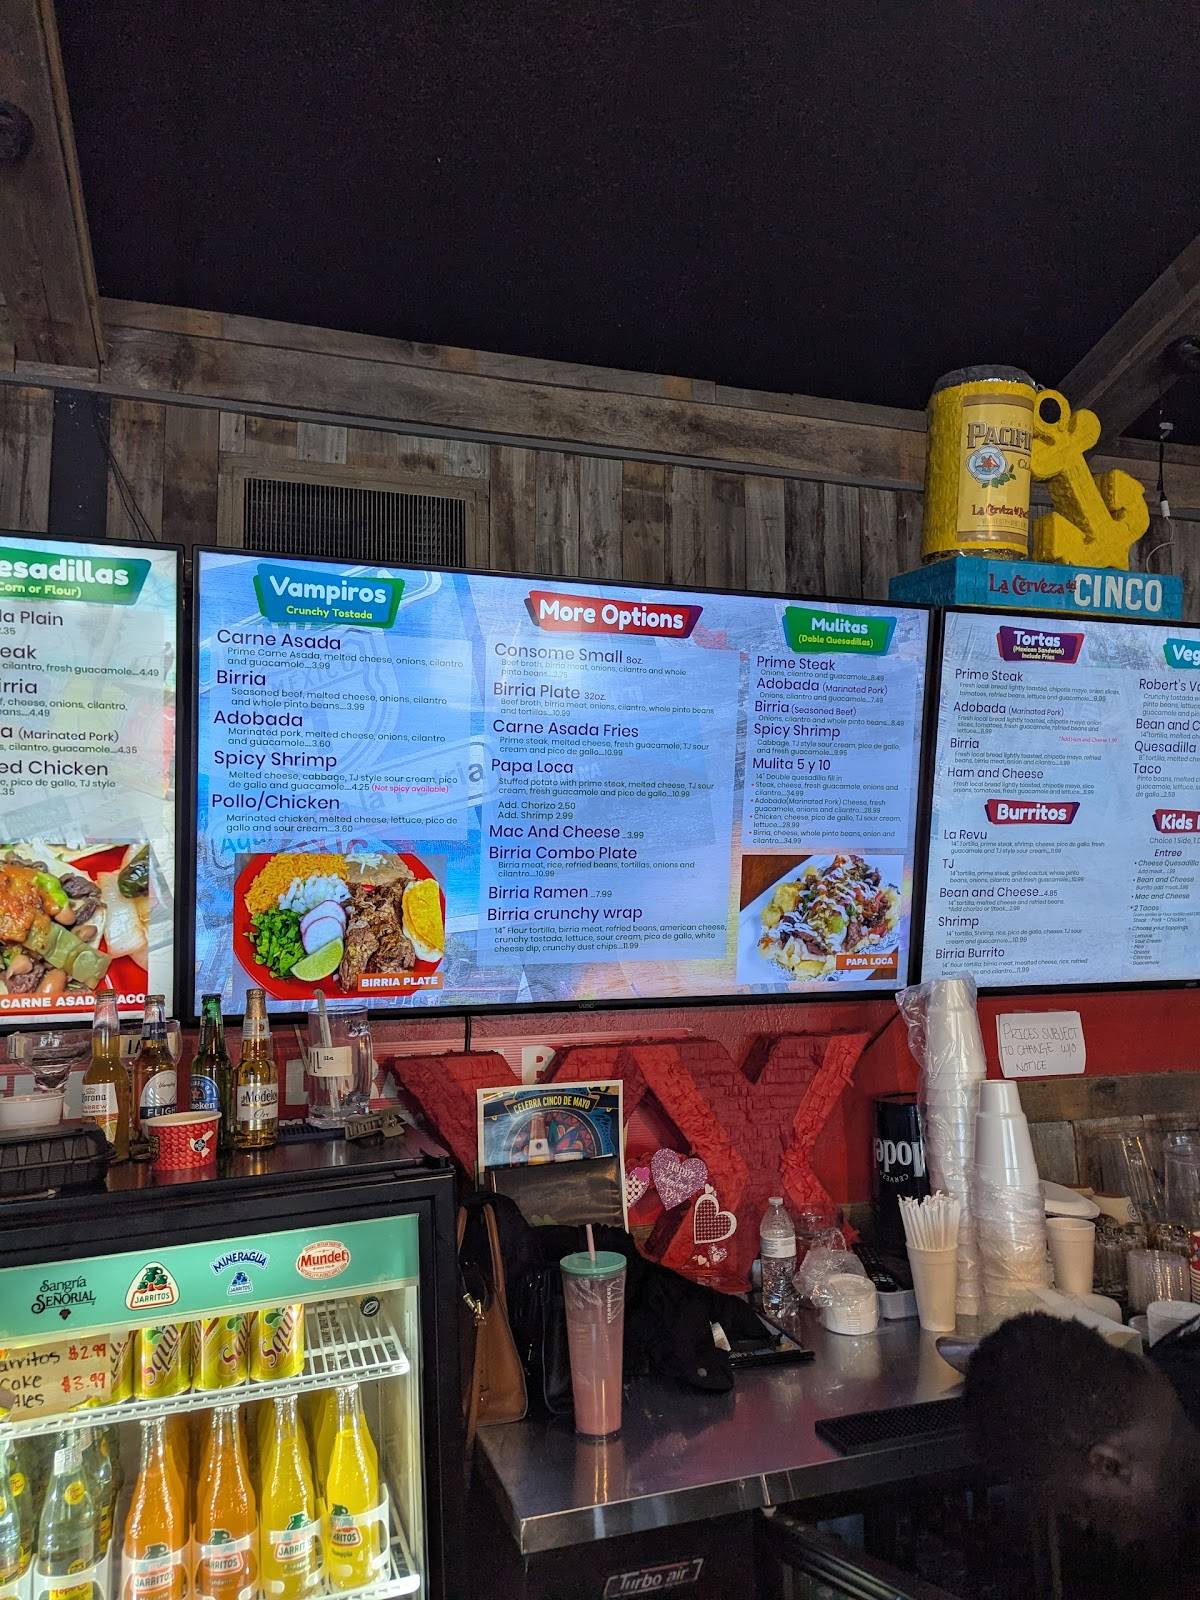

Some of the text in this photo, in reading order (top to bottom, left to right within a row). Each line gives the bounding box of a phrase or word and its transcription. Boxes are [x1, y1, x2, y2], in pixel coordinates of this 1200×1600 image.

[971, 504, 985, 515] La
[28, 584, 82, 599] or Flour)
[269, 575, 387, 606] Vampiros
[989, 574, 1009, 593] La
[1012, 574, 1064, 596] Cerveza
[1074, 573, 1163, 612] CINCO
[20, 611, 64, 626] Plain
[286, 605, 373, 620] Crunchy Tostada
[539, 600, 684, 631] More Options
[811, 617, 868, 634] Mulitas
[217, 629, 341, 650] Carne Asada
[826, 636, 874, 648] Quesadillas)
[1013, 631, 1061, 648] Tortas
[1, 645, 37, 660] eak
[227, 647, 256, 657] Prime
[258, 648, 288, 658] Carne
[324, 652, 357, 663] melted
[430, 658, 463, 668] cilantro
[495, 643, 575, 660] Consome
[579, 648, 622, 663] Small
[757, 656, 835, 672] Prime Steak
[217, 670, 266, 686] Birria
[955, 668, 1023, 682] Prime Steak
[493, 682, 536, 697] Birria
[540, 684, 580, 699] Plate
[756, 678, 888, 695] Adobada (Marinated Pork)
[1139, 679, 1186, 692] Robert's
[754, 700, 857, 717] Birria (Seasoned Beef)
[953, 702, 1064, 717] Adobada (Marinated Pork)
[213, 710, 303, 727] Adobada
[1136, 718, 1190, 730] Bean and
[493, 720, 639, 738] Carne Asada Fries
[754, 723, 841, 741] Spicy Shrimp
[19, 730, 119, 744] (Marinated Pork)
[950, 738, 979, 749] Birria
[1134, 741, 1196, 753] Quesadilla
[29, 760, 108, 776] Chicken
[214, 751, 337, 771] Spicy Shrimp
[491, 759, 574, 774] Papa Loca
[752, 758, 831, 774] Mulita 5 y 10
[1133, 763, 1161, 774] Taco
[947, 767, 1044, 779] Ham and Cheese
[212, 793, 340, 811] Pollo/Chicken
[498, 801, 576, 810] Add. Chorizo 2.50
[498, 811, 574, 820] Add. Shrimp 2.99
[997, 803, 1067, 821] Burritos
[1161, 814, 1193, 830] Kids
[489, 825, 620, 838] Mac And Cheese
[944, 830, 987, 839] La Revu
[489, 846, 637, 859] Birria Combo Plate
[1154, 849, 1182, 857] Entree
[942, 859, 954, 869] TJ
[489, 886, 588, 898] Birria Ramen
[939, 887, 994, 898] Bean and
[488, 907, 643, 923] Birria crunchy wrap
[938, 916, 979, 928] Shrimp
[935, 947, 1005, 959] Birria Burrito
[846, 957, 894, 966] PAPA LOCA
[361, 976, 438, 987] BIRRIA PLATE
[1, 995, 97, 1009] CARNE ASAD
[1003, 1022, 1079, 1040] PRICES SUBJECT
[1002, 1045, 1014, 1056] TO
[1016, 1042, 1054, 1056] CHANGE
[1016, 1060, 1047, 1072] NOTICE
[513, 1096, 591, 1114] CELEBRA CINCO DE MAYO
[213, 1251, 267, 1272] MINERAGUA
[300, 1250, 348, 1268] Mundet
[40, 1275, 87, 1292] Sangría
[31, 1290, 96, 1314] SEÑORIAL
[134, 1291, 170, 1304] JARRITOS
[69, 1344, 106, 1361] $2.99
[61, 1372, 106, 1393] $3.99
[134, 1571, 174, 1587] JARRITOS
[620, 1566, 689, 1590] Turbo air
